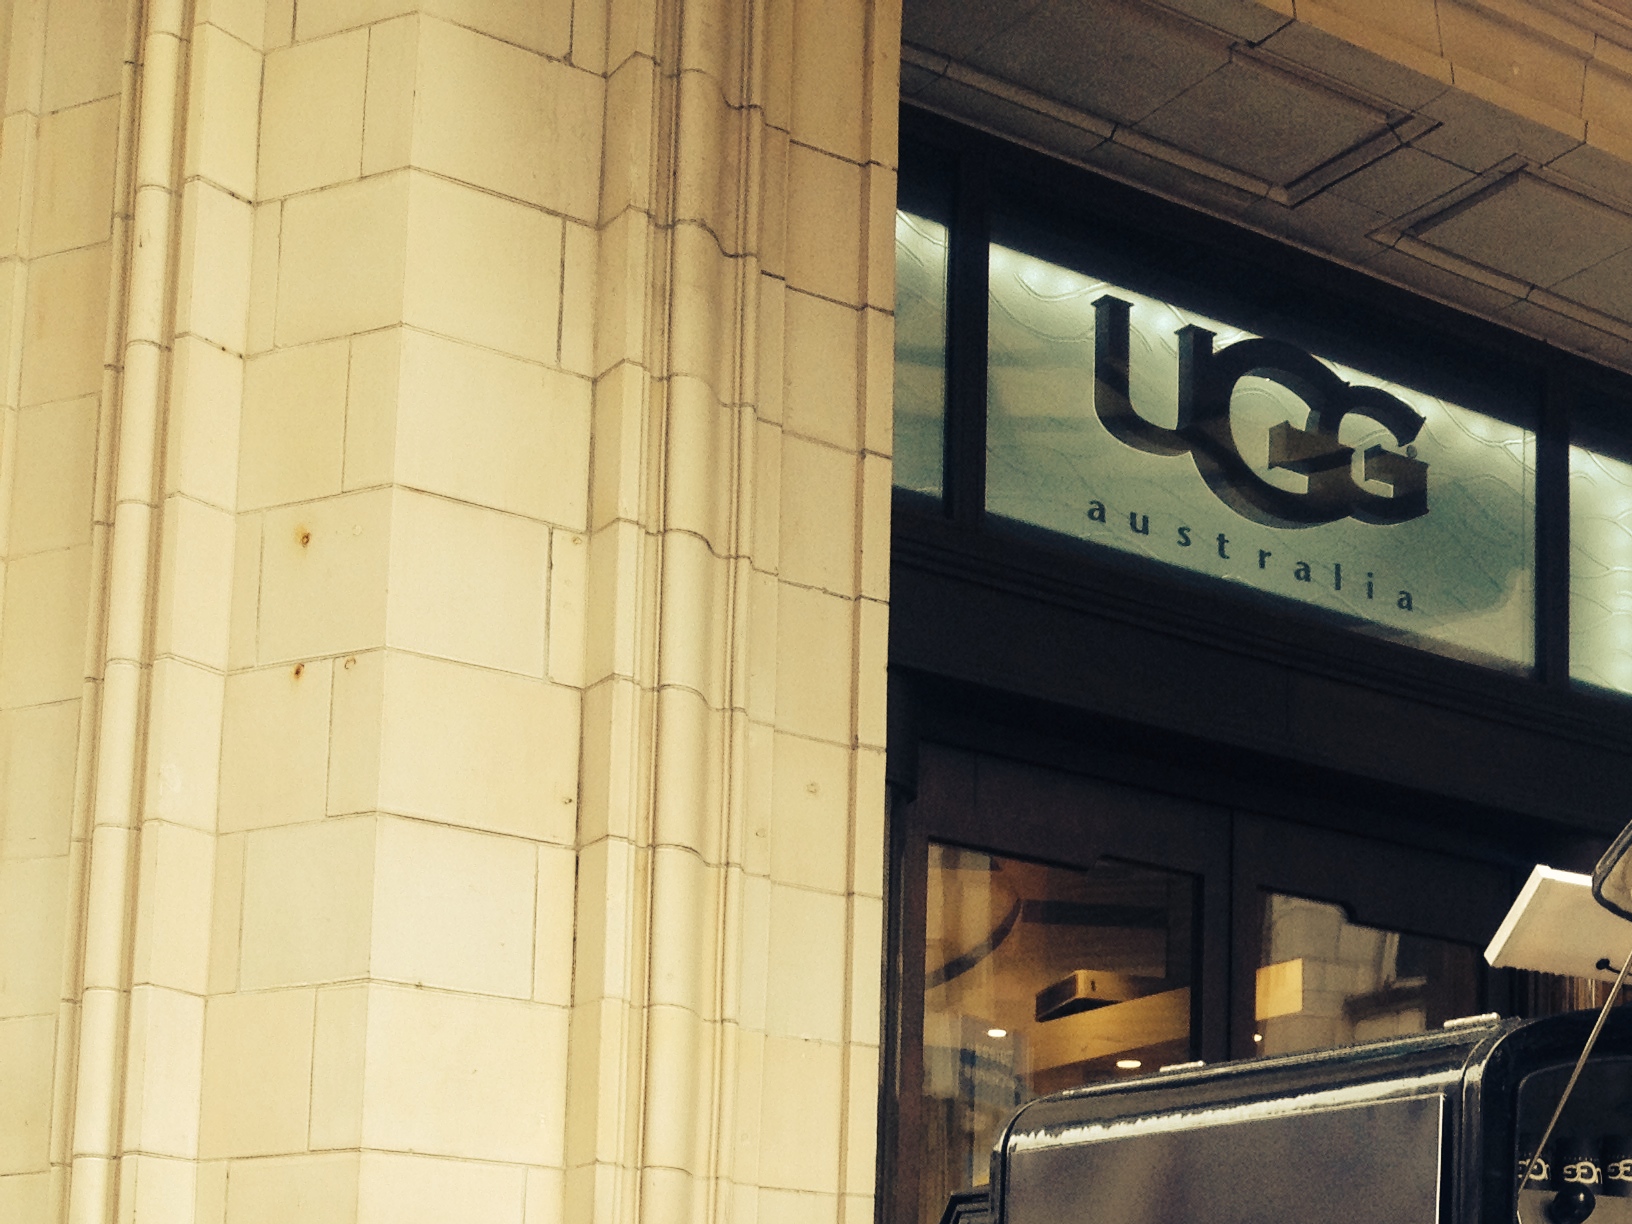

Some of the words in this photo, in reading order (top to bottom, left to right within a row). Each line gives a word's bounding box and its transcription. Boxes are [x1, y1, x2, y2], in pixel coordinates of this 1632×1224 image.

[1091, 294, 1430, 530] UGG
[1087, 499, 1414, 613] australia
[1562, 1160, 1603, 1185] UGG
